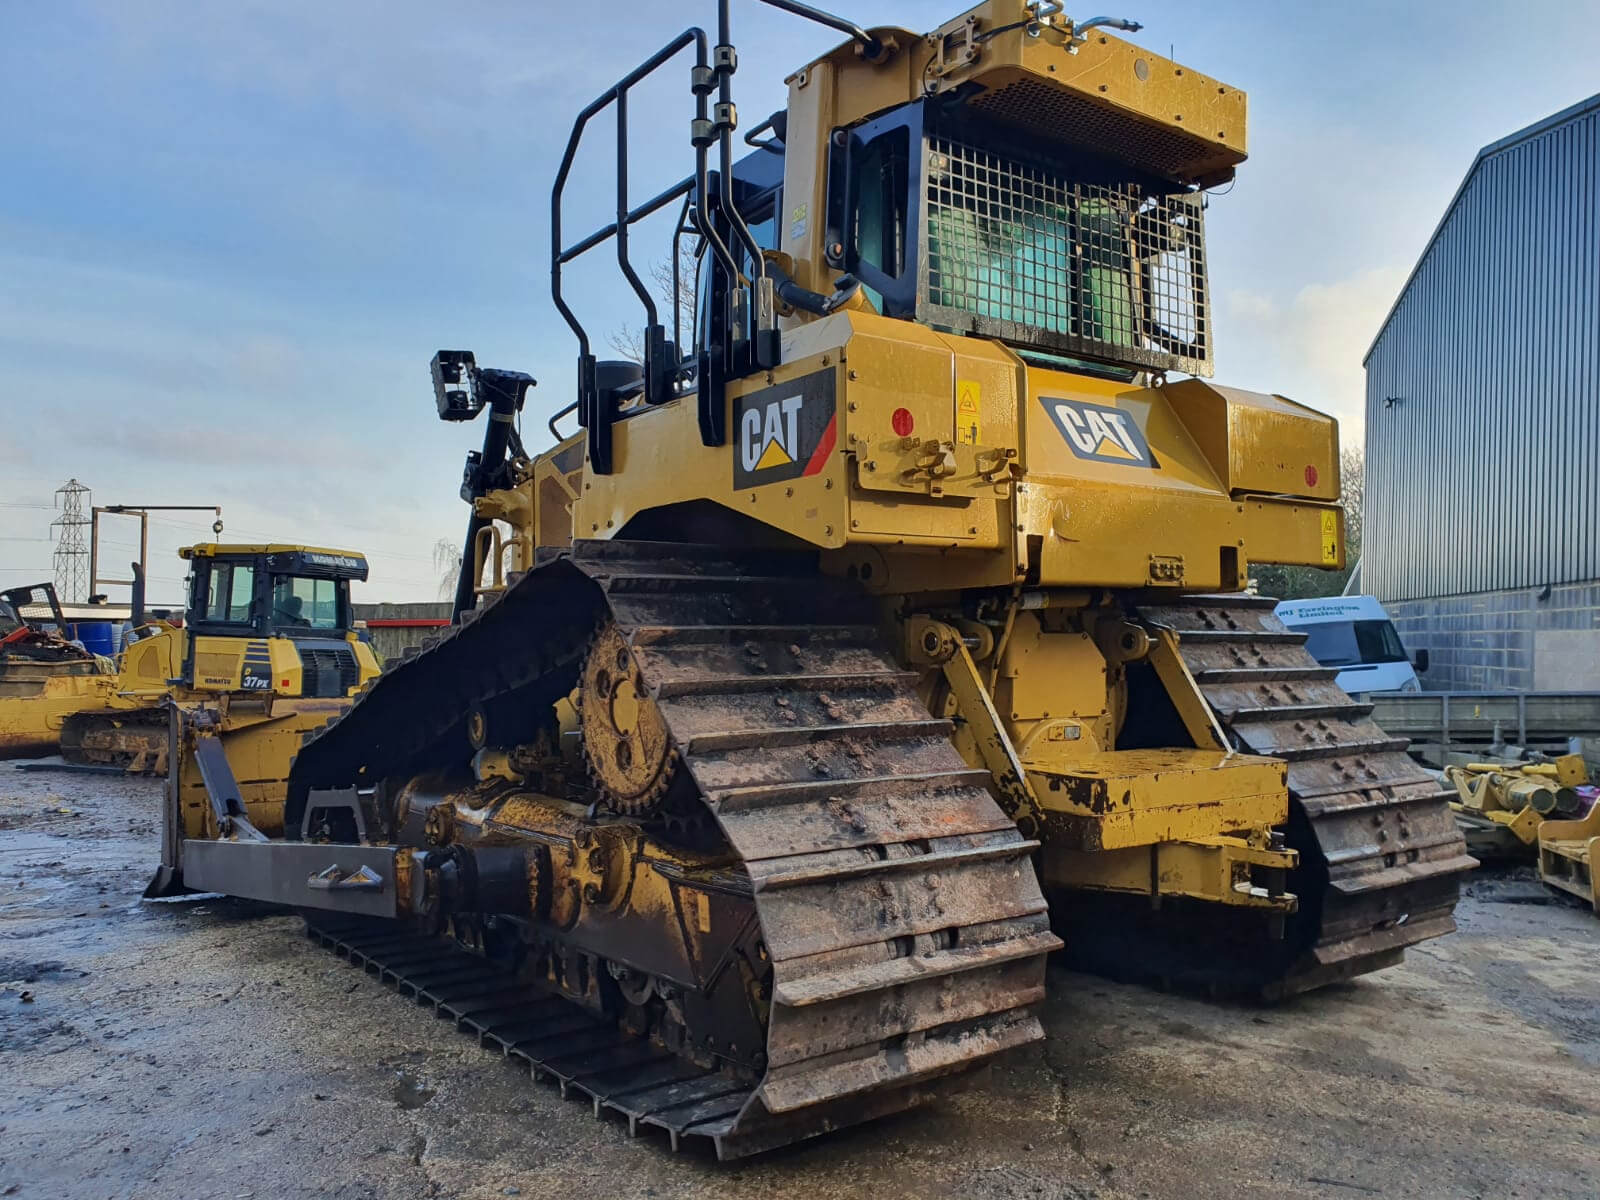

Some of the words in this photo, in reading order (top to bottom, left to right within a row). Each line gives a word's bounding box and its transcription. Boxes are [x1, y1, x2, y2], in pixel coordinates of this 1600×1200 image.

[742, 395, 802, 472] CAT
[1055, 405, 1144, 460] CAT
[243, 676, 269, 688] 37PX
